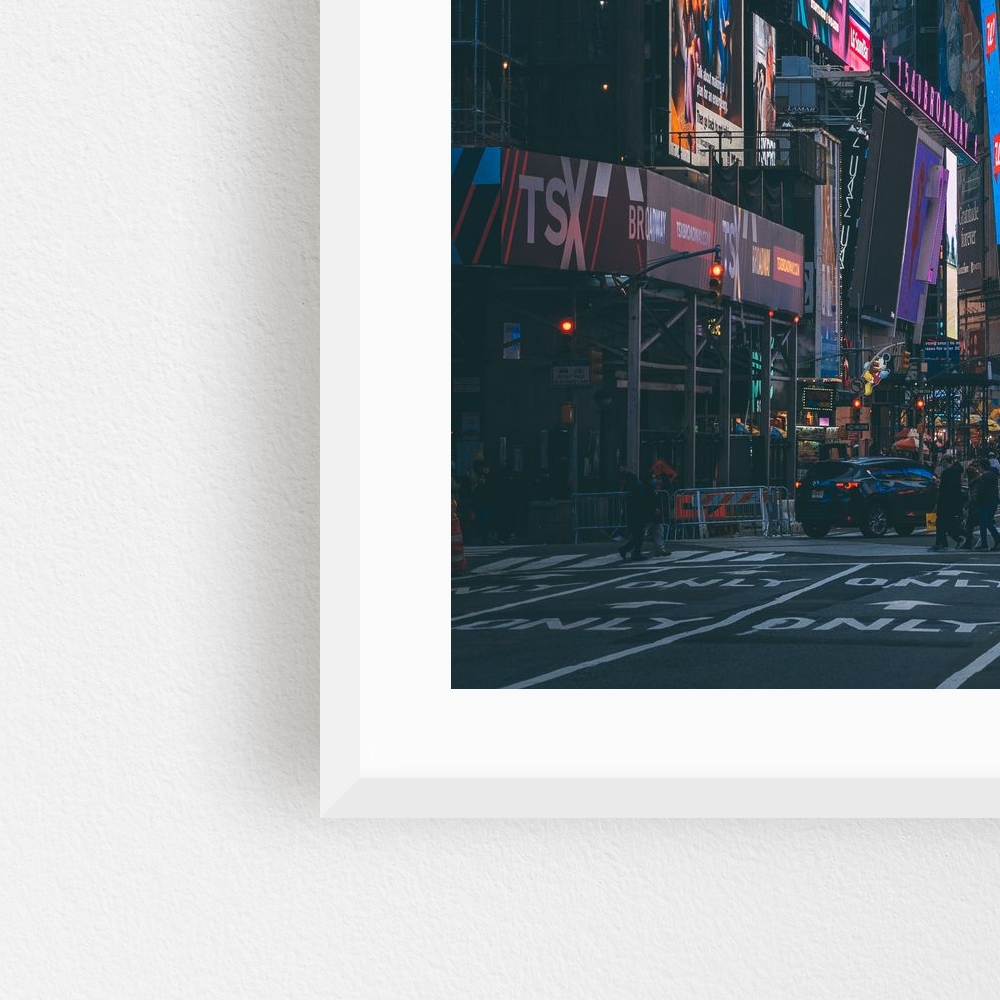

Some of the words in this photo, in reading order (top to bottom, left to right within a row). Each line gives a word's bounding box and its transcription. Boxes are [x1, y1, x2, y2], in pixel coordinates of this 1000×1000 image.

[518, 156, 588, 271] TSX
[628, 204, 667, 244] BROADWAY
[452, 582, 590, 595] NLY
[615, 577, 812, 590] ONLY
[452, 617, 715, 631] ONLY
